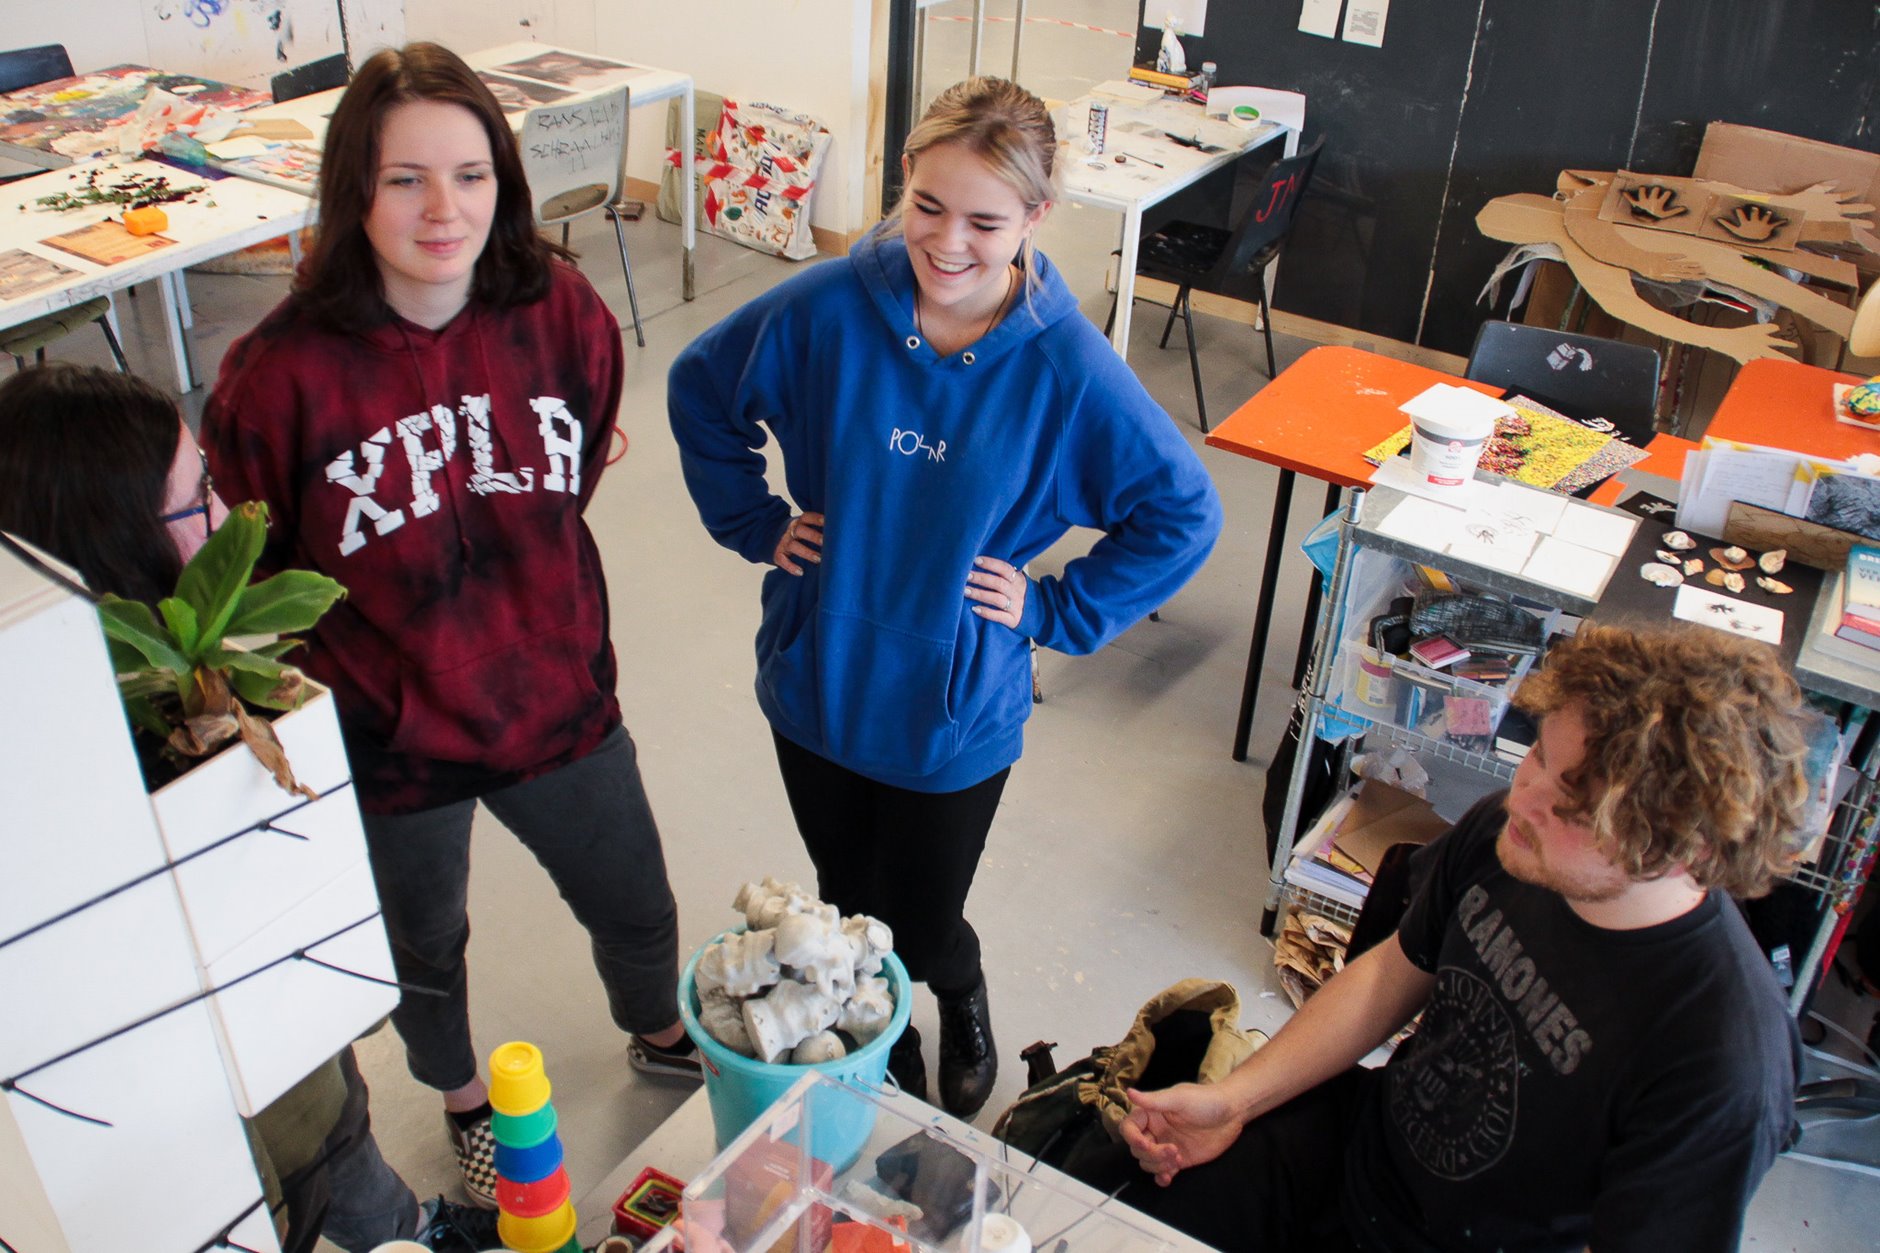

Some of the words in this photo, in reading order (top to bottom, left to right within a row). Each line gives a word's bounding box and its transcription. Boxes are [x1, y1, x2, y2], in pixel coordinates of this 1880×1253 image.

[754, 142, 782, 216] ACIO
[325, 393, 583, 557] XPLR
[889, 427, 947, 463] POLAR
[1458, 884, 1593, 1075] RAMONES
